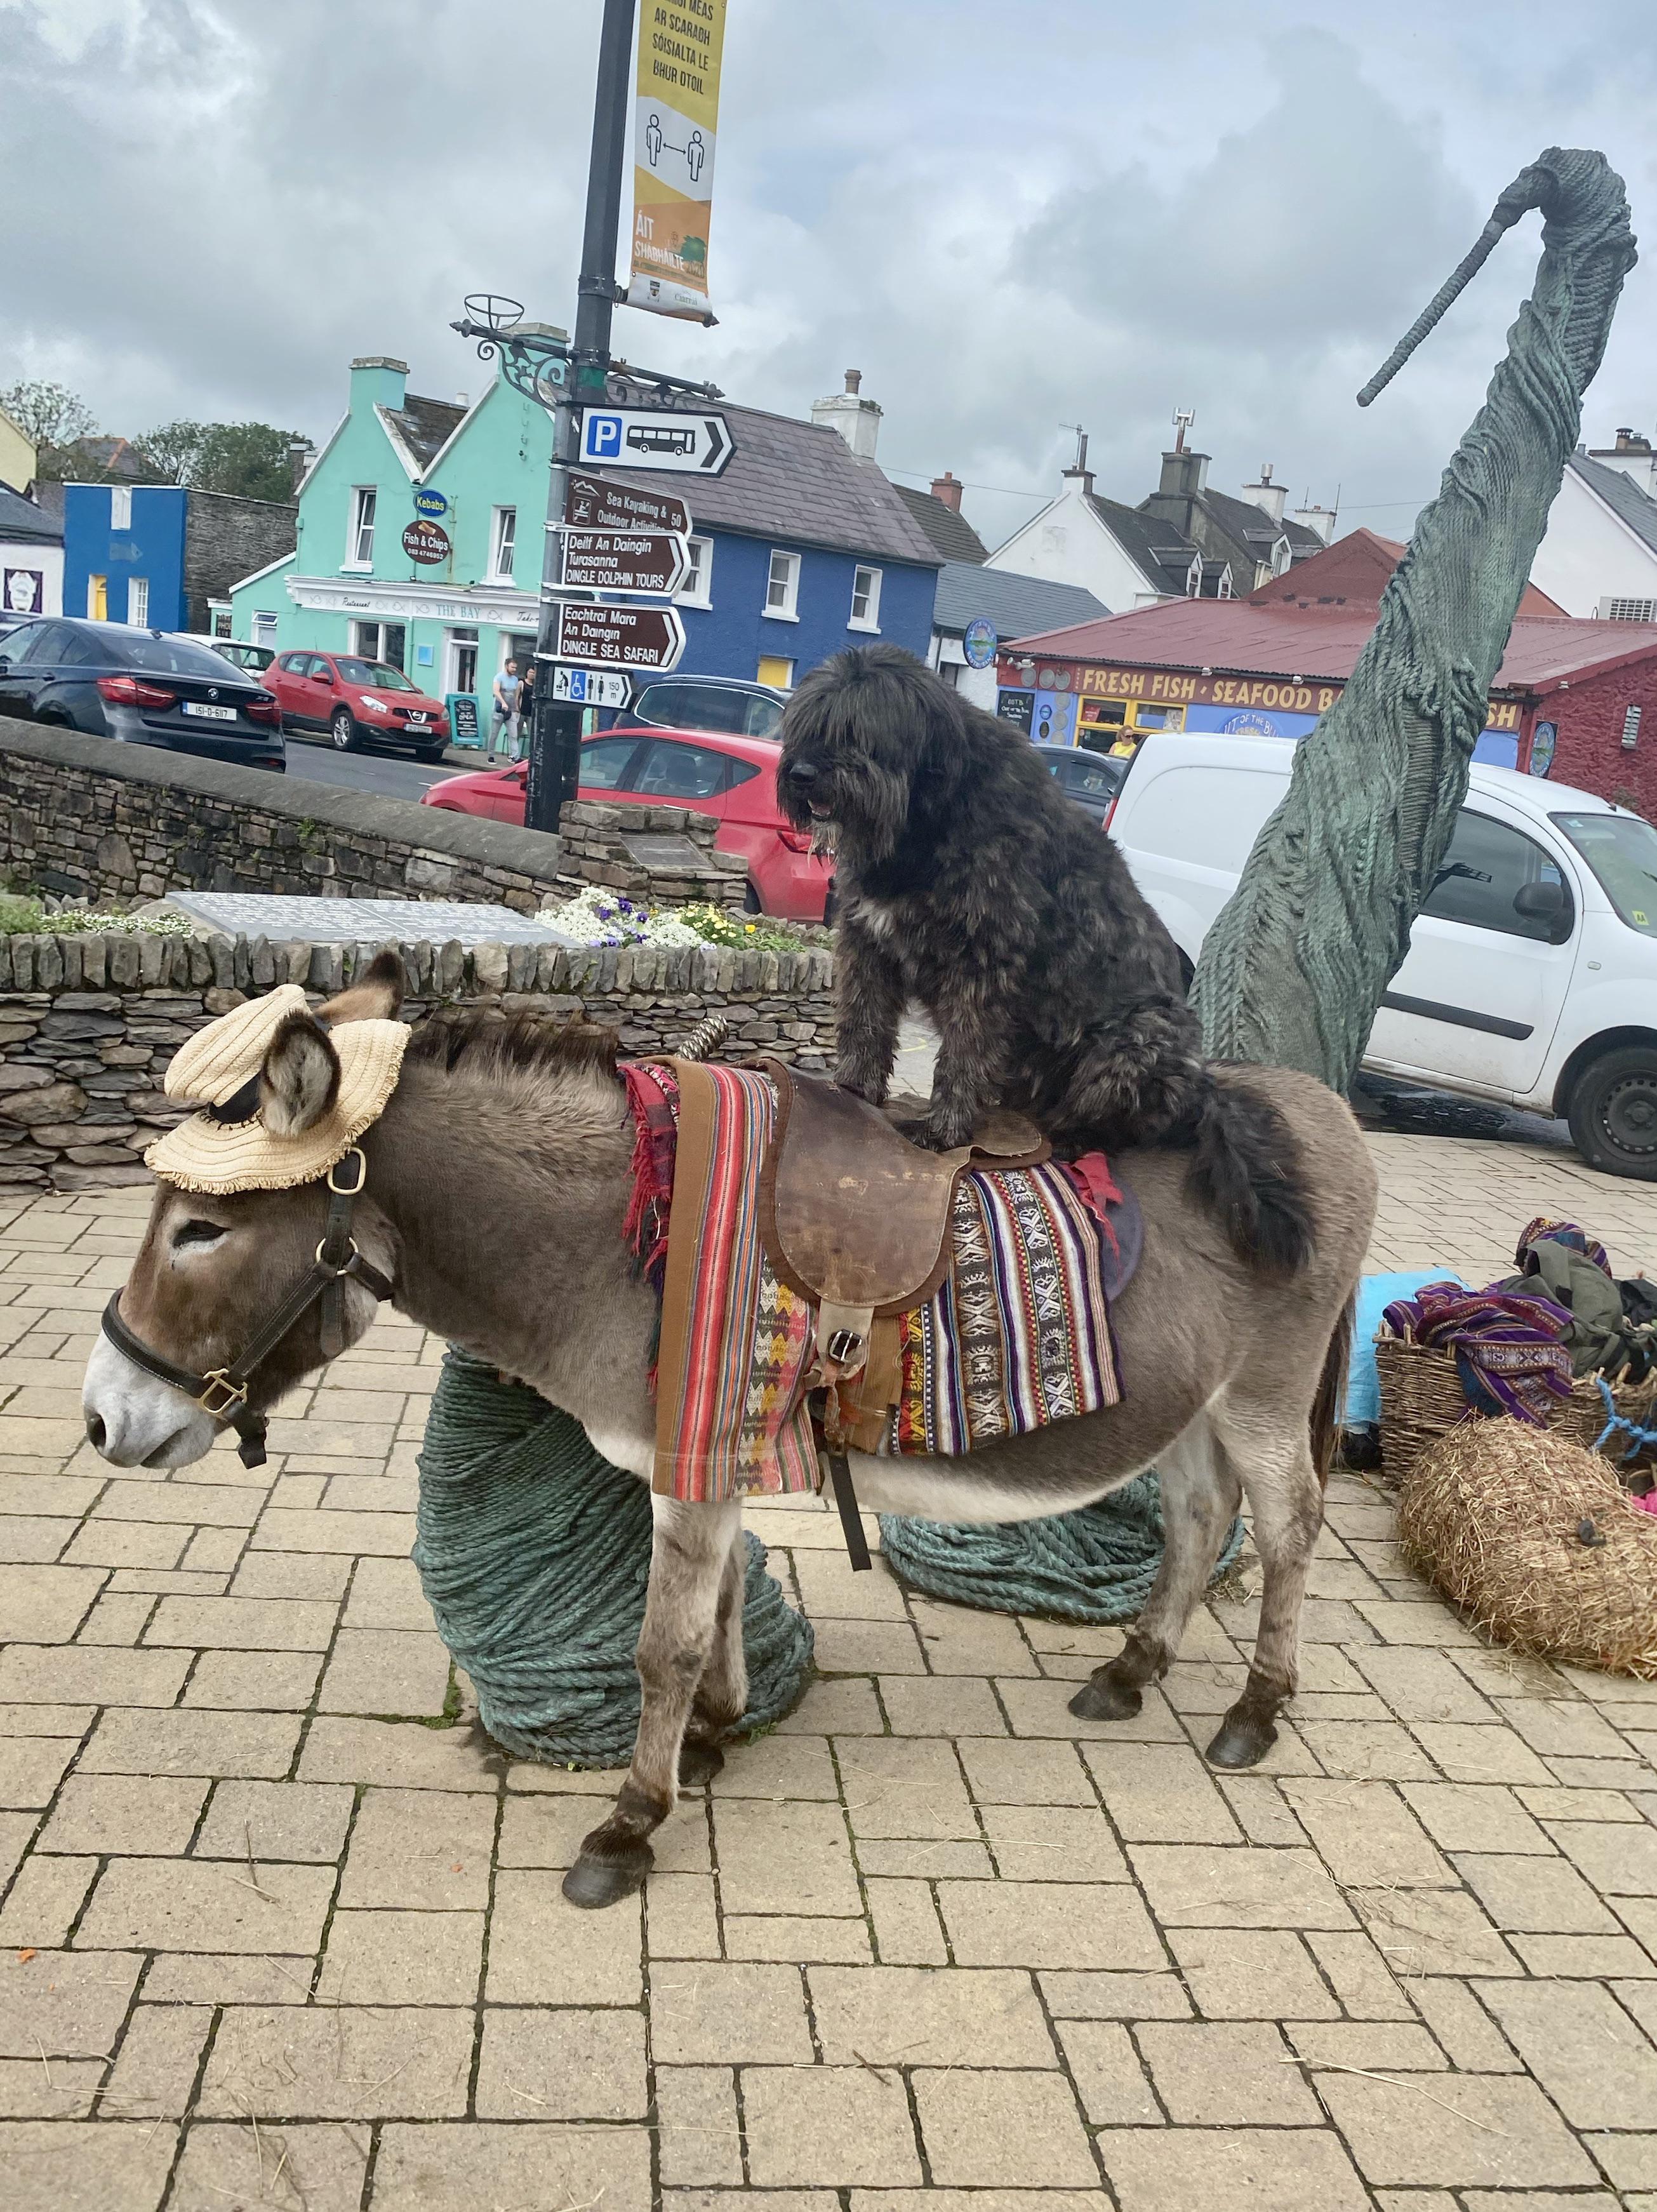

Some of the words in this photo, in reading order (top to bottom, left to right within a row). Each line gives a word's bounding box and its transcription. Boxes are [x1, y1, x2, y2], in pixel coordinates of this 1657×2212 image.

[654, 7, 667, 27] AR
[669, 13, 710, 46] SCARADH
[652, 32, 696, 66] SÓISIALTA
[698, 53, 709, 71] LE
[653, 59, 677, 84] BHUR
[680, 70, 704, 95] DTOIL
[636, 210, 654, 241] ÁIT
[594, 420, 617, 452] P
[416, 496, 444, 511] Kebabs
[606, 491, 622, 507] Sea
[623, 496, 658, 519] Kayaking
[660, 505, 667, 518] &
[671, 512, 682, 528] 50
[597, 509, 629, 528] Outdoor
[403, 531, 419, 545] Fish
[420, 535, 427, 547] &
[427, 536, 448, 552] Chips
[569, 535, 593, 550] Deilf
[595, 536, 610, 551] An
[613, 537, 652, 556] Daingin
[568, 552, 618, 568] Turasanna
[566, 569, 596, 583] DINGLE
[597, 571, 633, 586] DOLPHIN
[636, 573, 664, 589] TOURS
[436, 604, 455, 617] THE
[460, 606, 481, 619] BAY
[564, 606, 607, 623] Eachtraí
[610, 611, 637, 626] Mara
[564, 622, 578, 636] An
[582, 624, 620, 642] Daingin
[562, 640, 597, 656] DINGLE
[601, 643, 620, 659] SEA
[623, 646, 658, 663] SAFARI
[608, 681, 620, 691] 150
[1082, 670, 1145, 695] FRESH
[1151, 675, 1196, 700] FISH
[1211, 680, 1312, 710] SEAFOOD
[1240, 714, 1249, 724] OF
